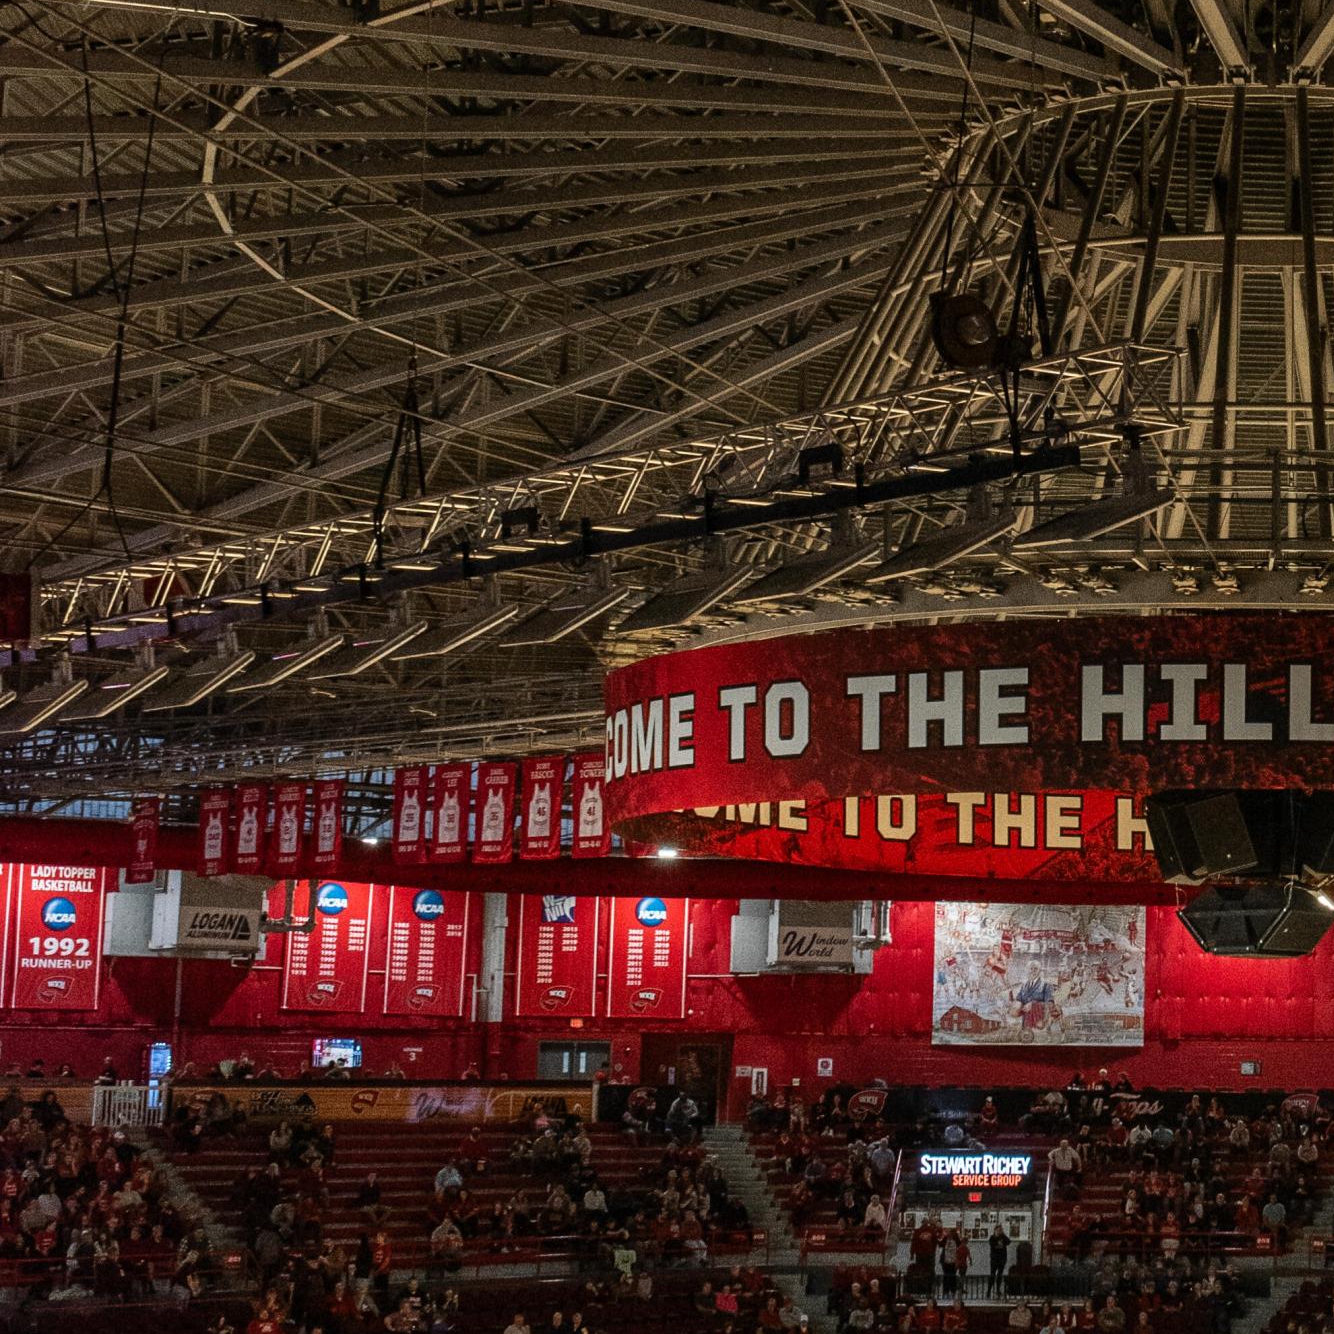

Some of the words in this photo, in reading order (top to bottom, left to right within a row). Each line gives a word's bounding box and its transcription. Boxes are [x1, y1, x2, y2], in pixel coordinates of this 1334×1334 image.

[720, 681, 809, 761] TO
[846, 667, 1029, 751] THE
[946, 792, 1082, 850] THE
[31, 866, 57, 877] LADY
[57, 866, 96, 879] TOPPER
[31, 880, 93, 892] BASKETBALL
[45, 913, 76, 924] NCAA
[190, 913, 236, 930] LOGAN
[29, 937, 90, 956] 1992
[21, 958, 93, 970] RUNNER-UP
[409, 1052, 417, 1061] 3
[920, 1154, 982, 1176] STEWART
[983, 1156, 1030, 1178] RICHEY
[952, 1174, 988, 1187] SERVICE
[990, 1175, 1022, 1187] GROUP
